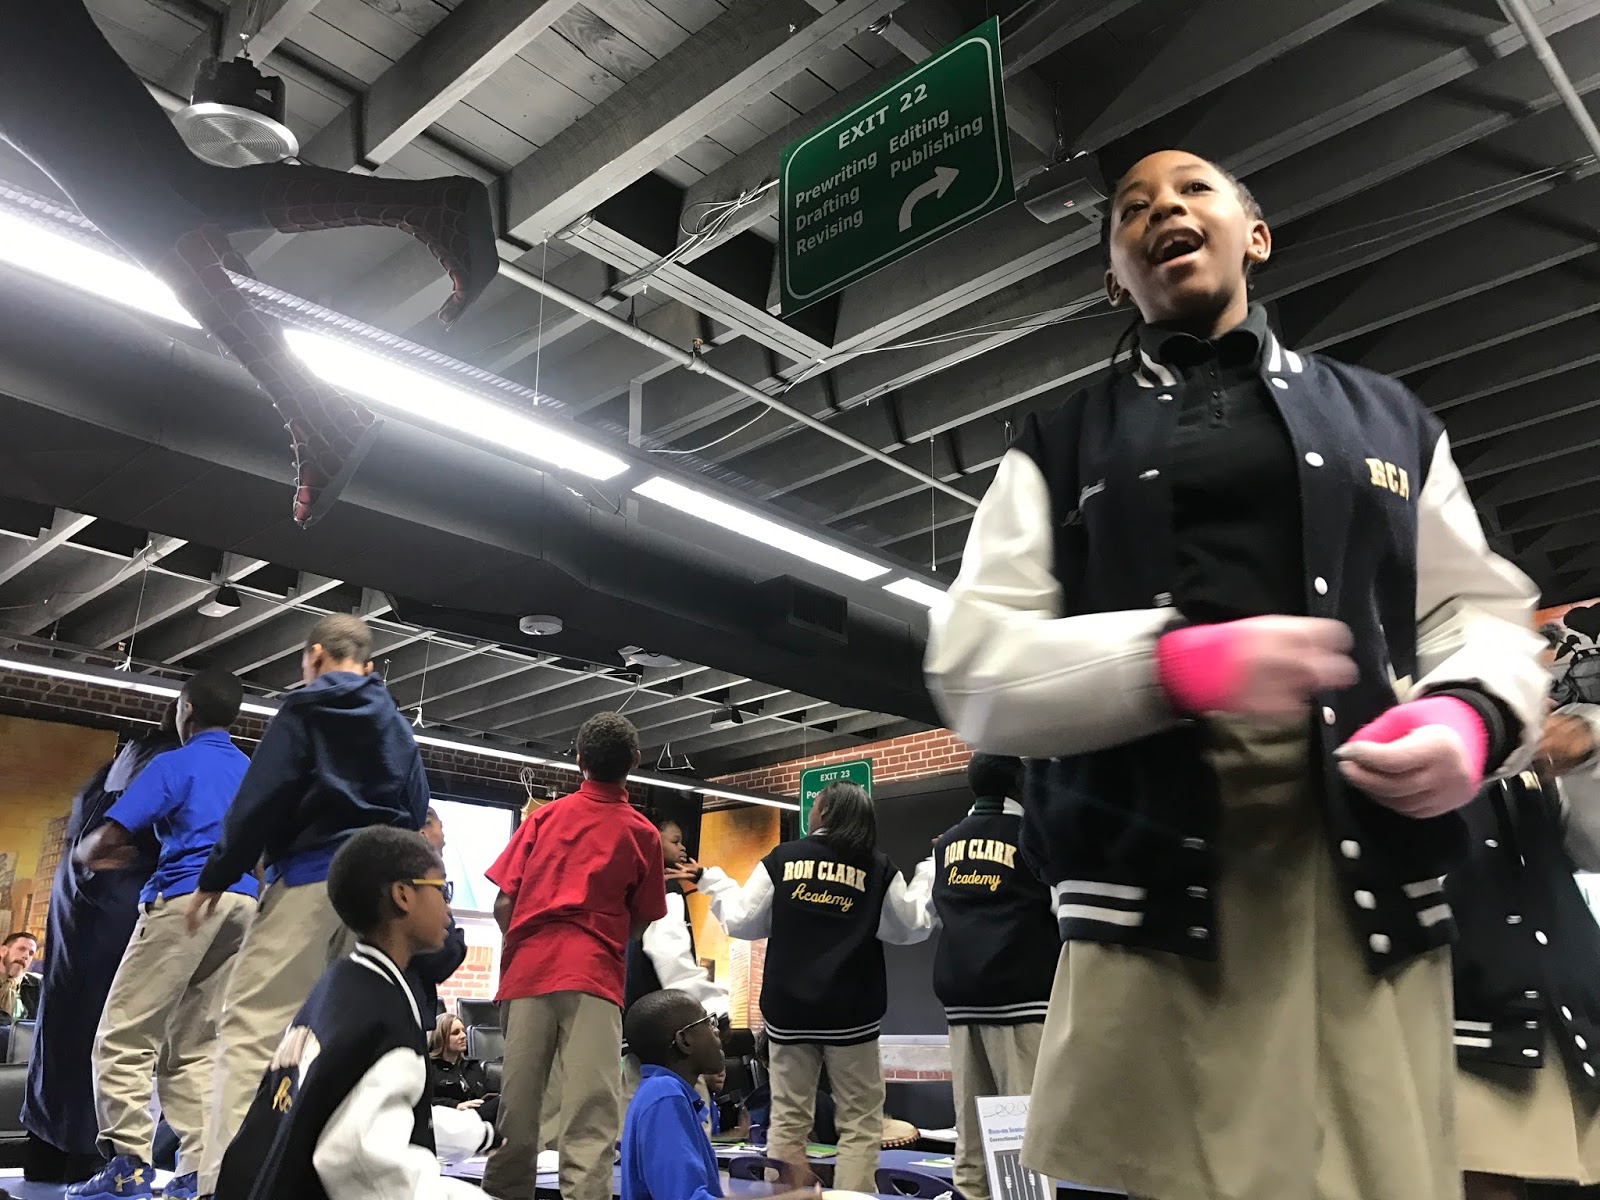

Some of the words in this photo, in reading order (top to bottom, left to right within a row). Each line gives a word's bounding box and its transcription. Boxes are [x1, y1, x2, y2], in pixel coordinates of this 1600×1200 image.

[838, 105, 889, 150] EXIT
[900, 83, 928, 113] 22
[889, 109, 950, 154] Editing
[890, 116, 983, 179] Publishing
[796, 151, 878, 208] Prewriting
[796, 186, 860, 232] Drafting
[796, 208, 864, 256] Revising
[820, 772, 838, 781] EXIT
[840, 769, 850, 778] 23
[782, 860, 815, 881] RON
[817, 861, 867, 892] CLARK
[944, 840, 967, 869] RON
[968, 838, 1017, 869] CLARK
[791, 883, 854, 912] Academy
[947, 866, 1001, 891] Academy
